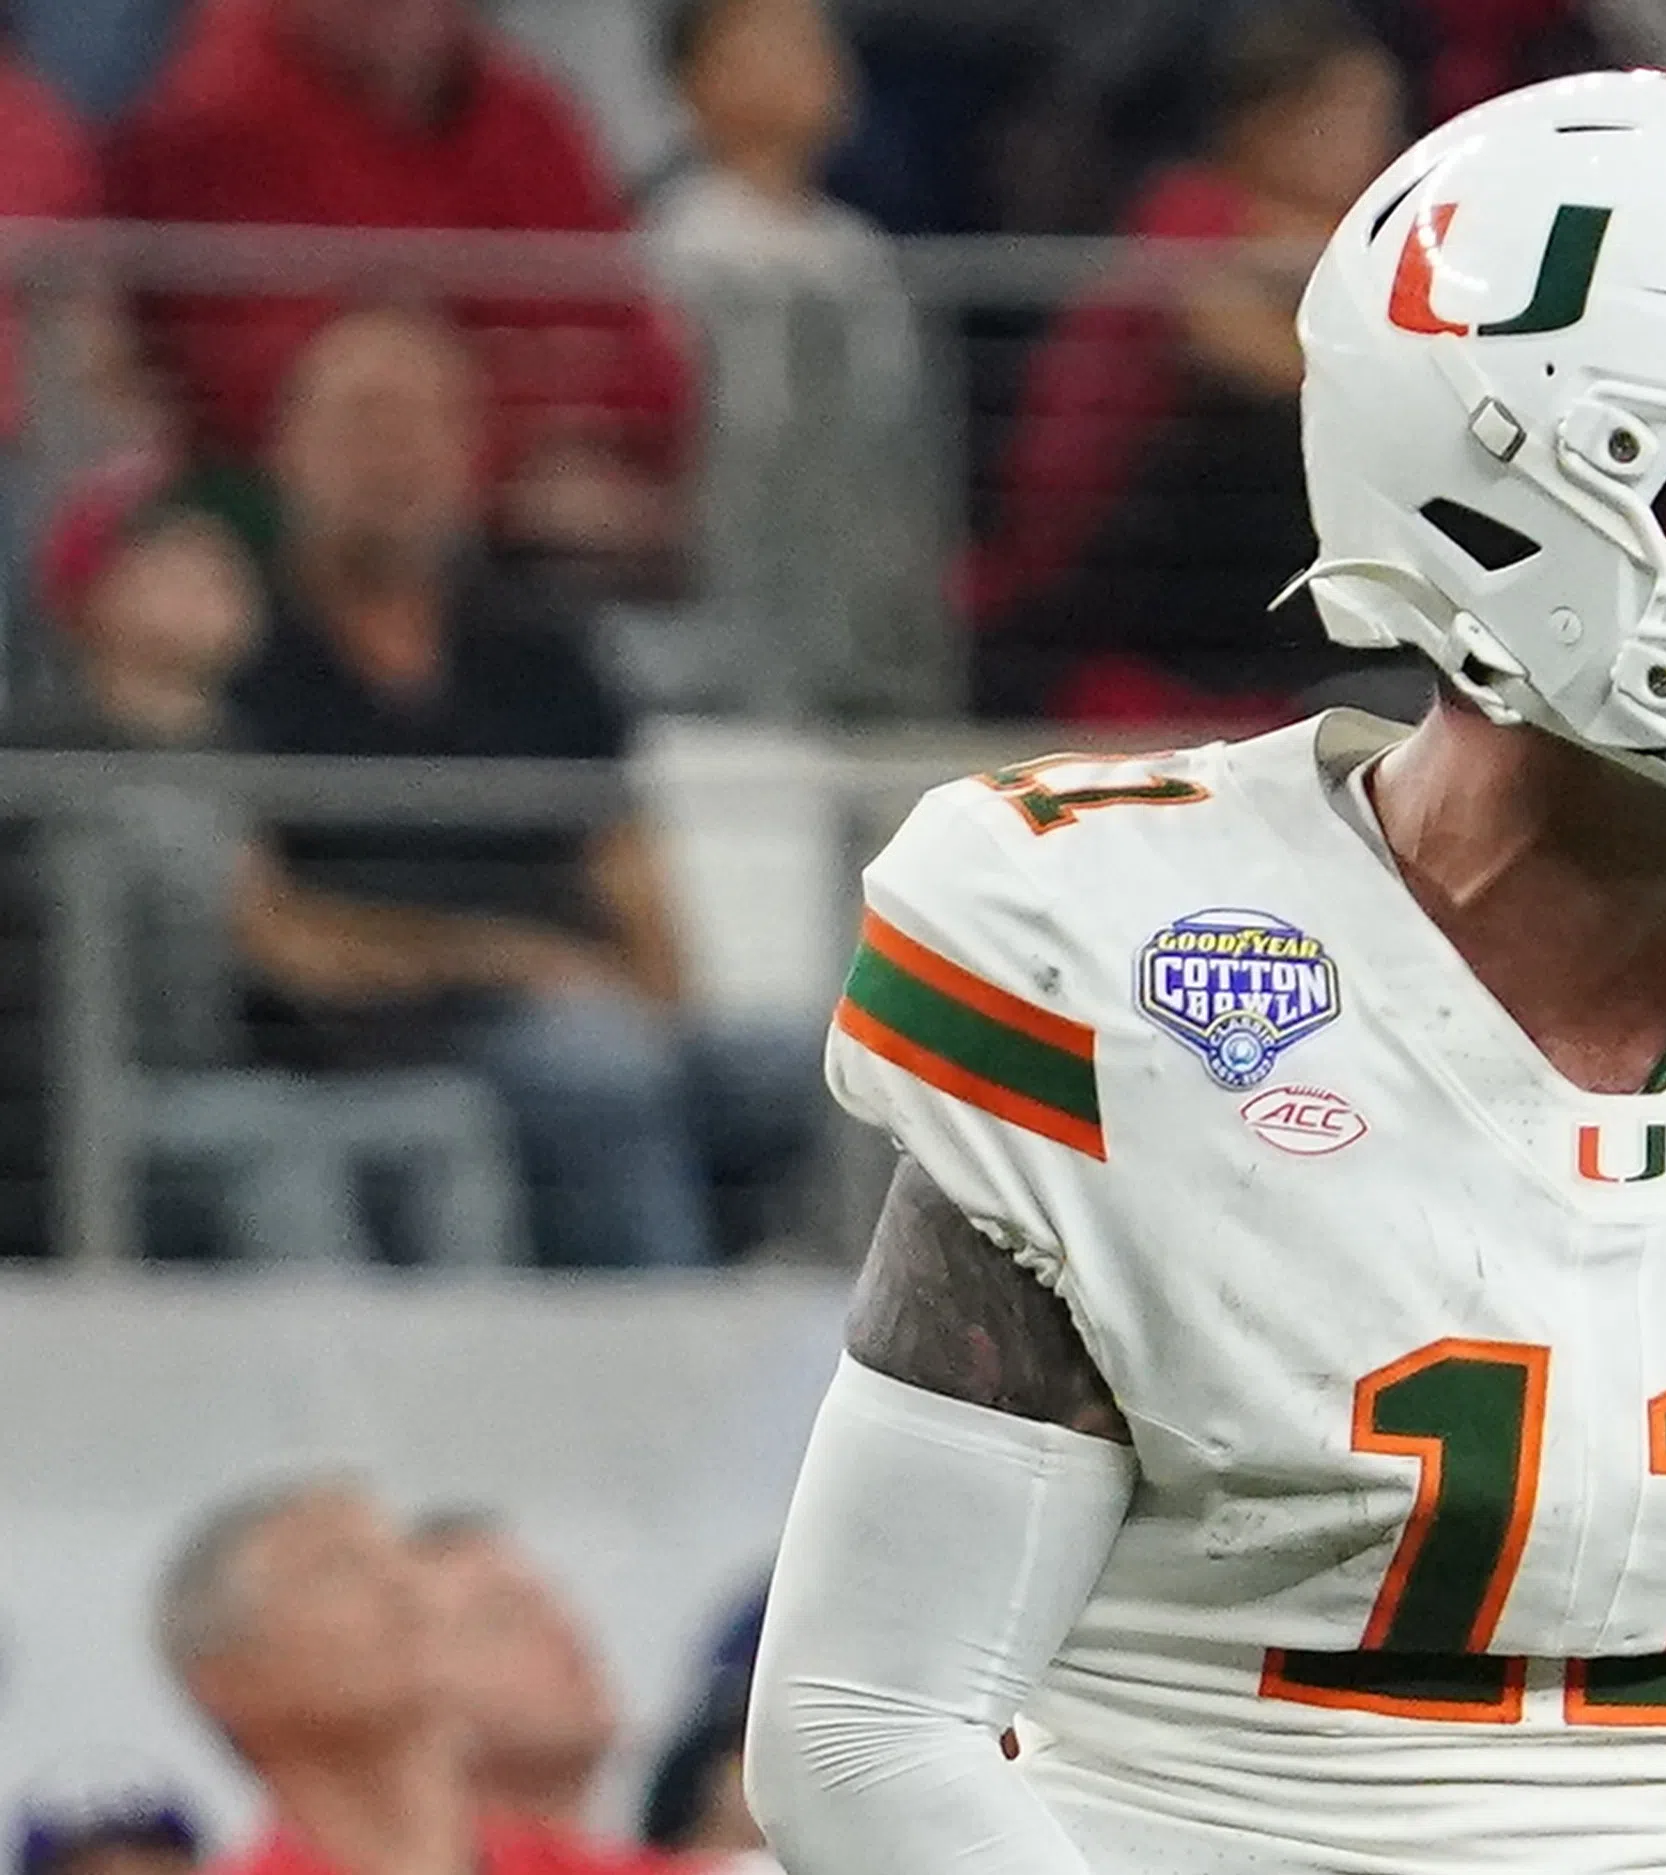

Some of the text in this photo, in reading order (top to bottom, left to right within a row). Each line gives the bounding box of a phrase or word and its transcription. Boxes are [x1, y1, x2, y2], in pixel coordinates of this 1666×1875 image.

[1388, 202, 1613, 337] U
[1158, 929, 1318, 957] GOODYEAR
[1154, 955, 1326, 1010] COTTON
[1187, 990, 1298, 1023] BOWL
[1260, 1102, 1351, 1131] ACC
[1578, 1125, 1666, 1182] U
